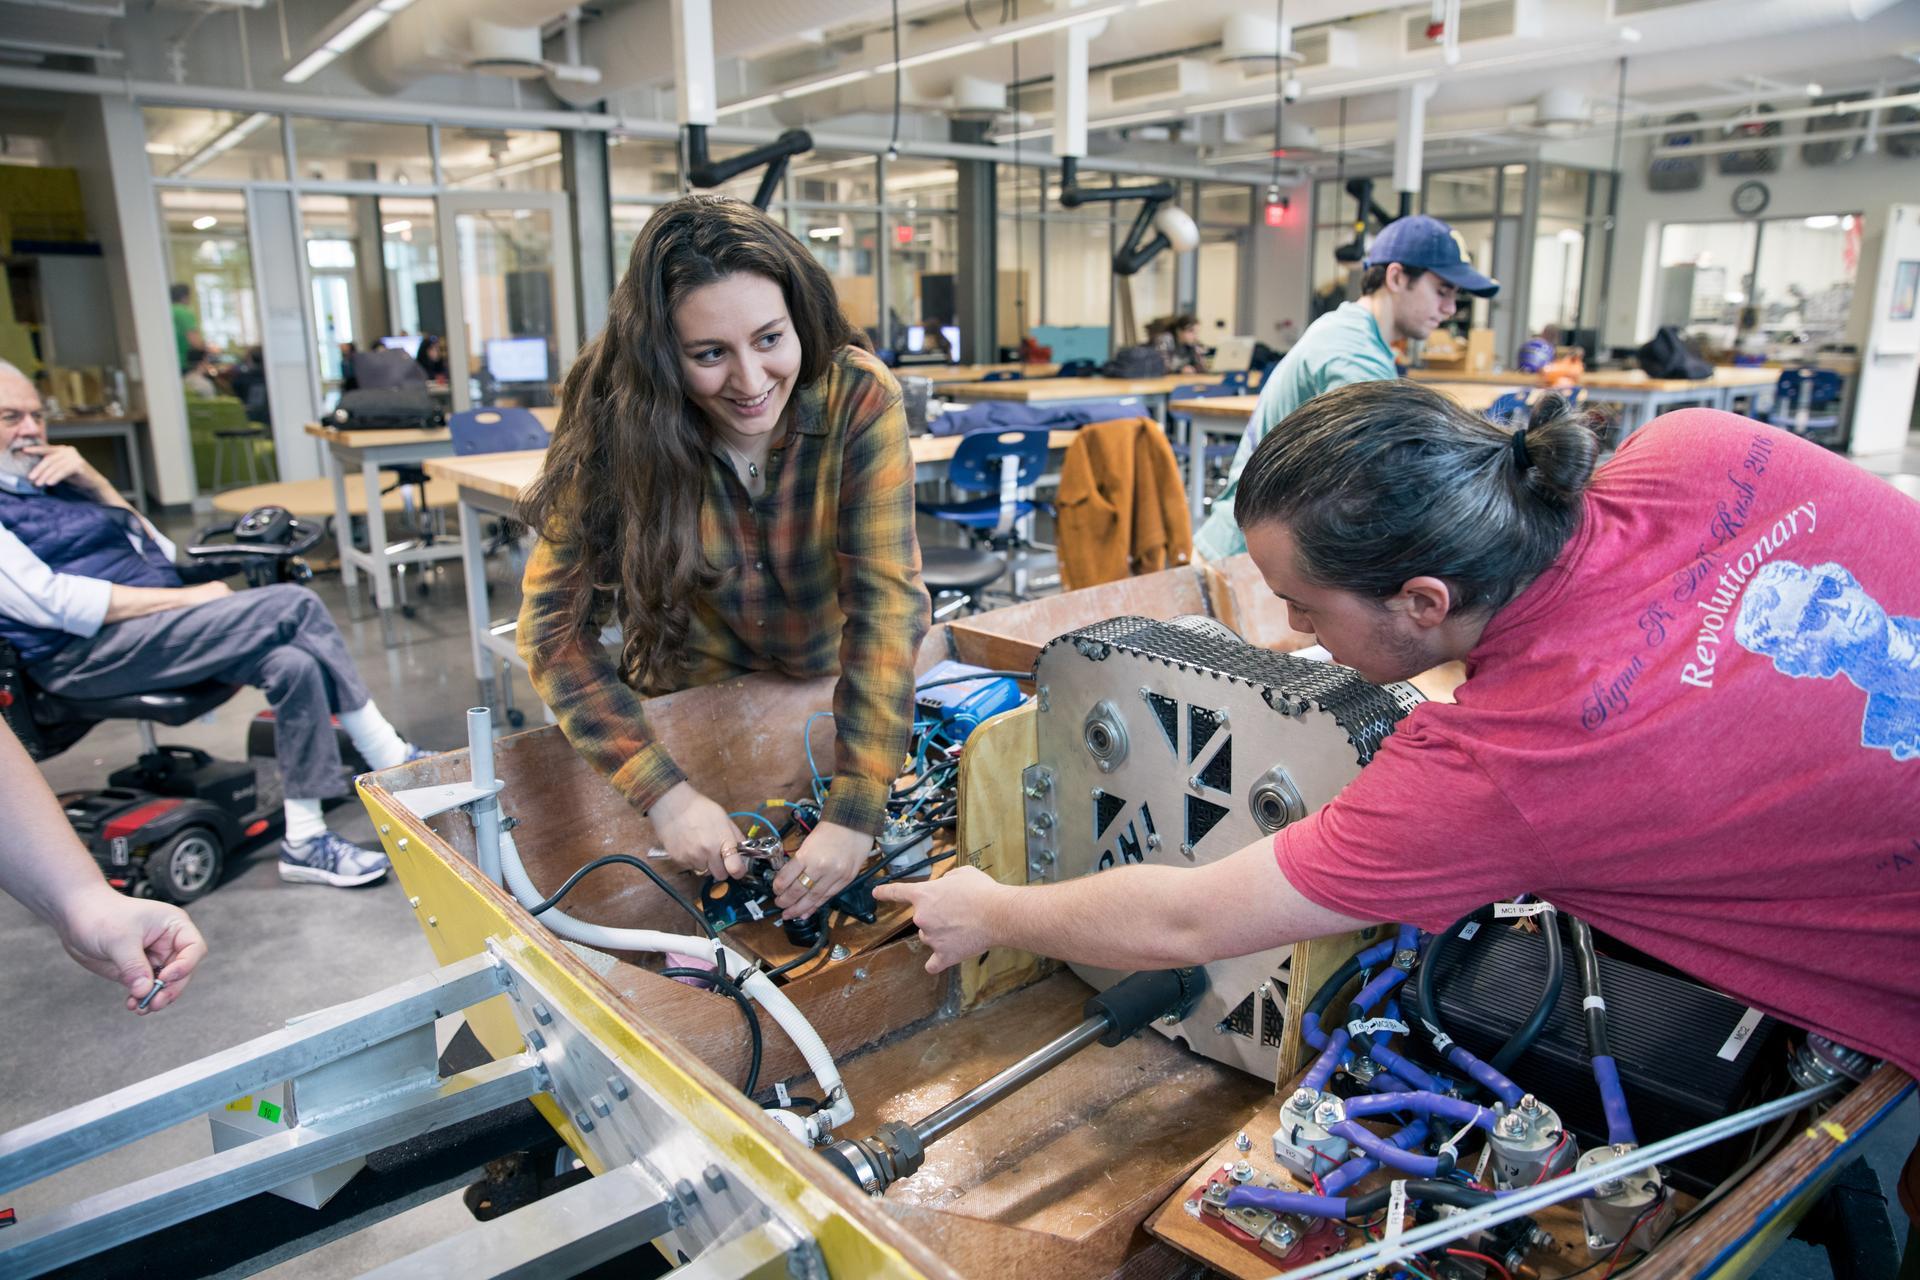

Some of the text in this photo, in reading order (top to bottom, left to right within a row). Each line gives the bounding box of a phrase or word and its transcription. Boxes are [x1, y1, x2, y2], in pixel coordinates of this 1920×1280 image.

[1581, 654, 1645, 731] Sigma
[1710, 469, 1757, 546] Rush
[1680, 501, 1817, 689] Revolutionary
